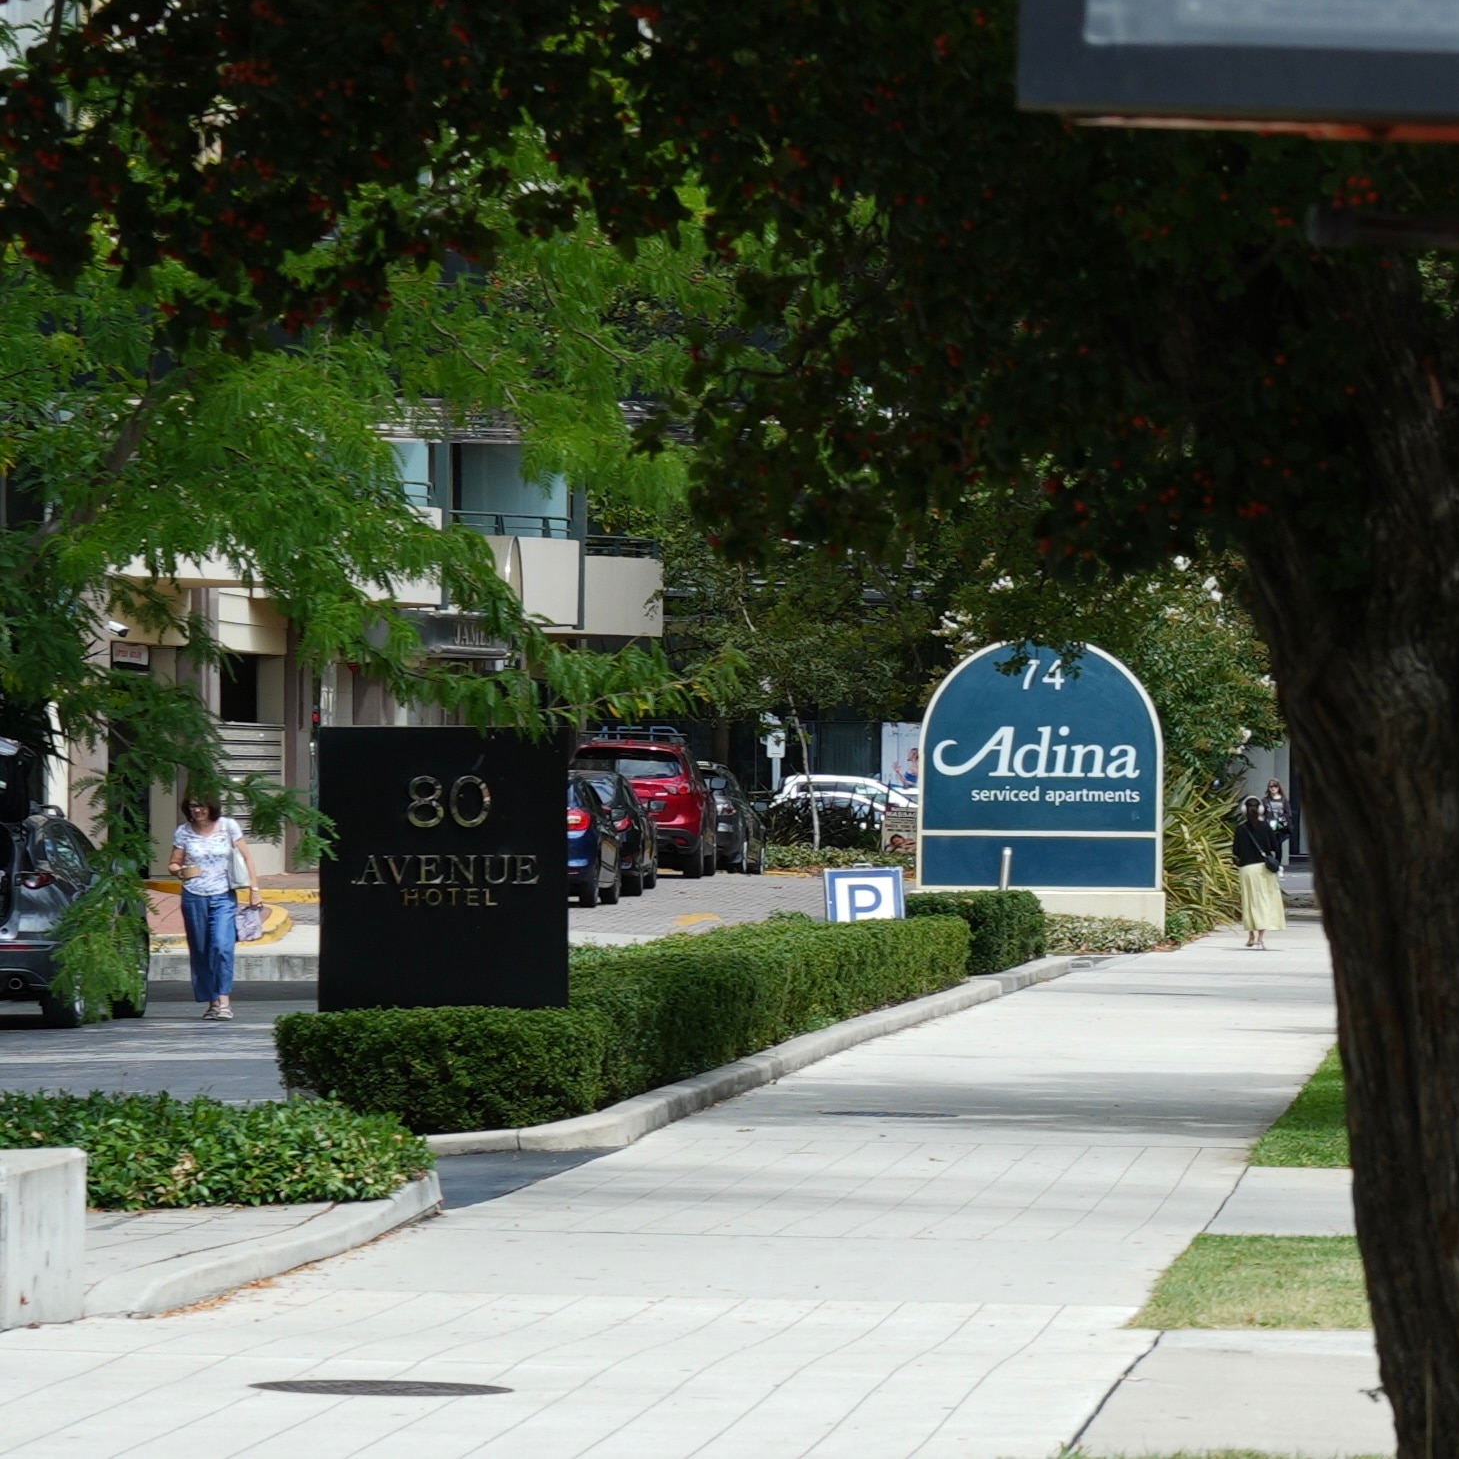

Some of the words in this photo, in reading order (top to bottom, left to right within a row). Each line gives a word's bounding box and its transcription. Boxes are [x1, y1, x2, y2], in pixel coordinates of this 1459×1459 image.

[1022, 659, 1065, 690] 74
[932, 725, 1141, 779] Adina
[407, 775, 491, 828] 80
[971, 786, 1040, 802] serviced
[1045, 787, 1141, 806] apartments
[351, 854, 541, 885] AVENUE
[400, 888, 498, 907] HOTEL
[849, 883, 882, 913] P
